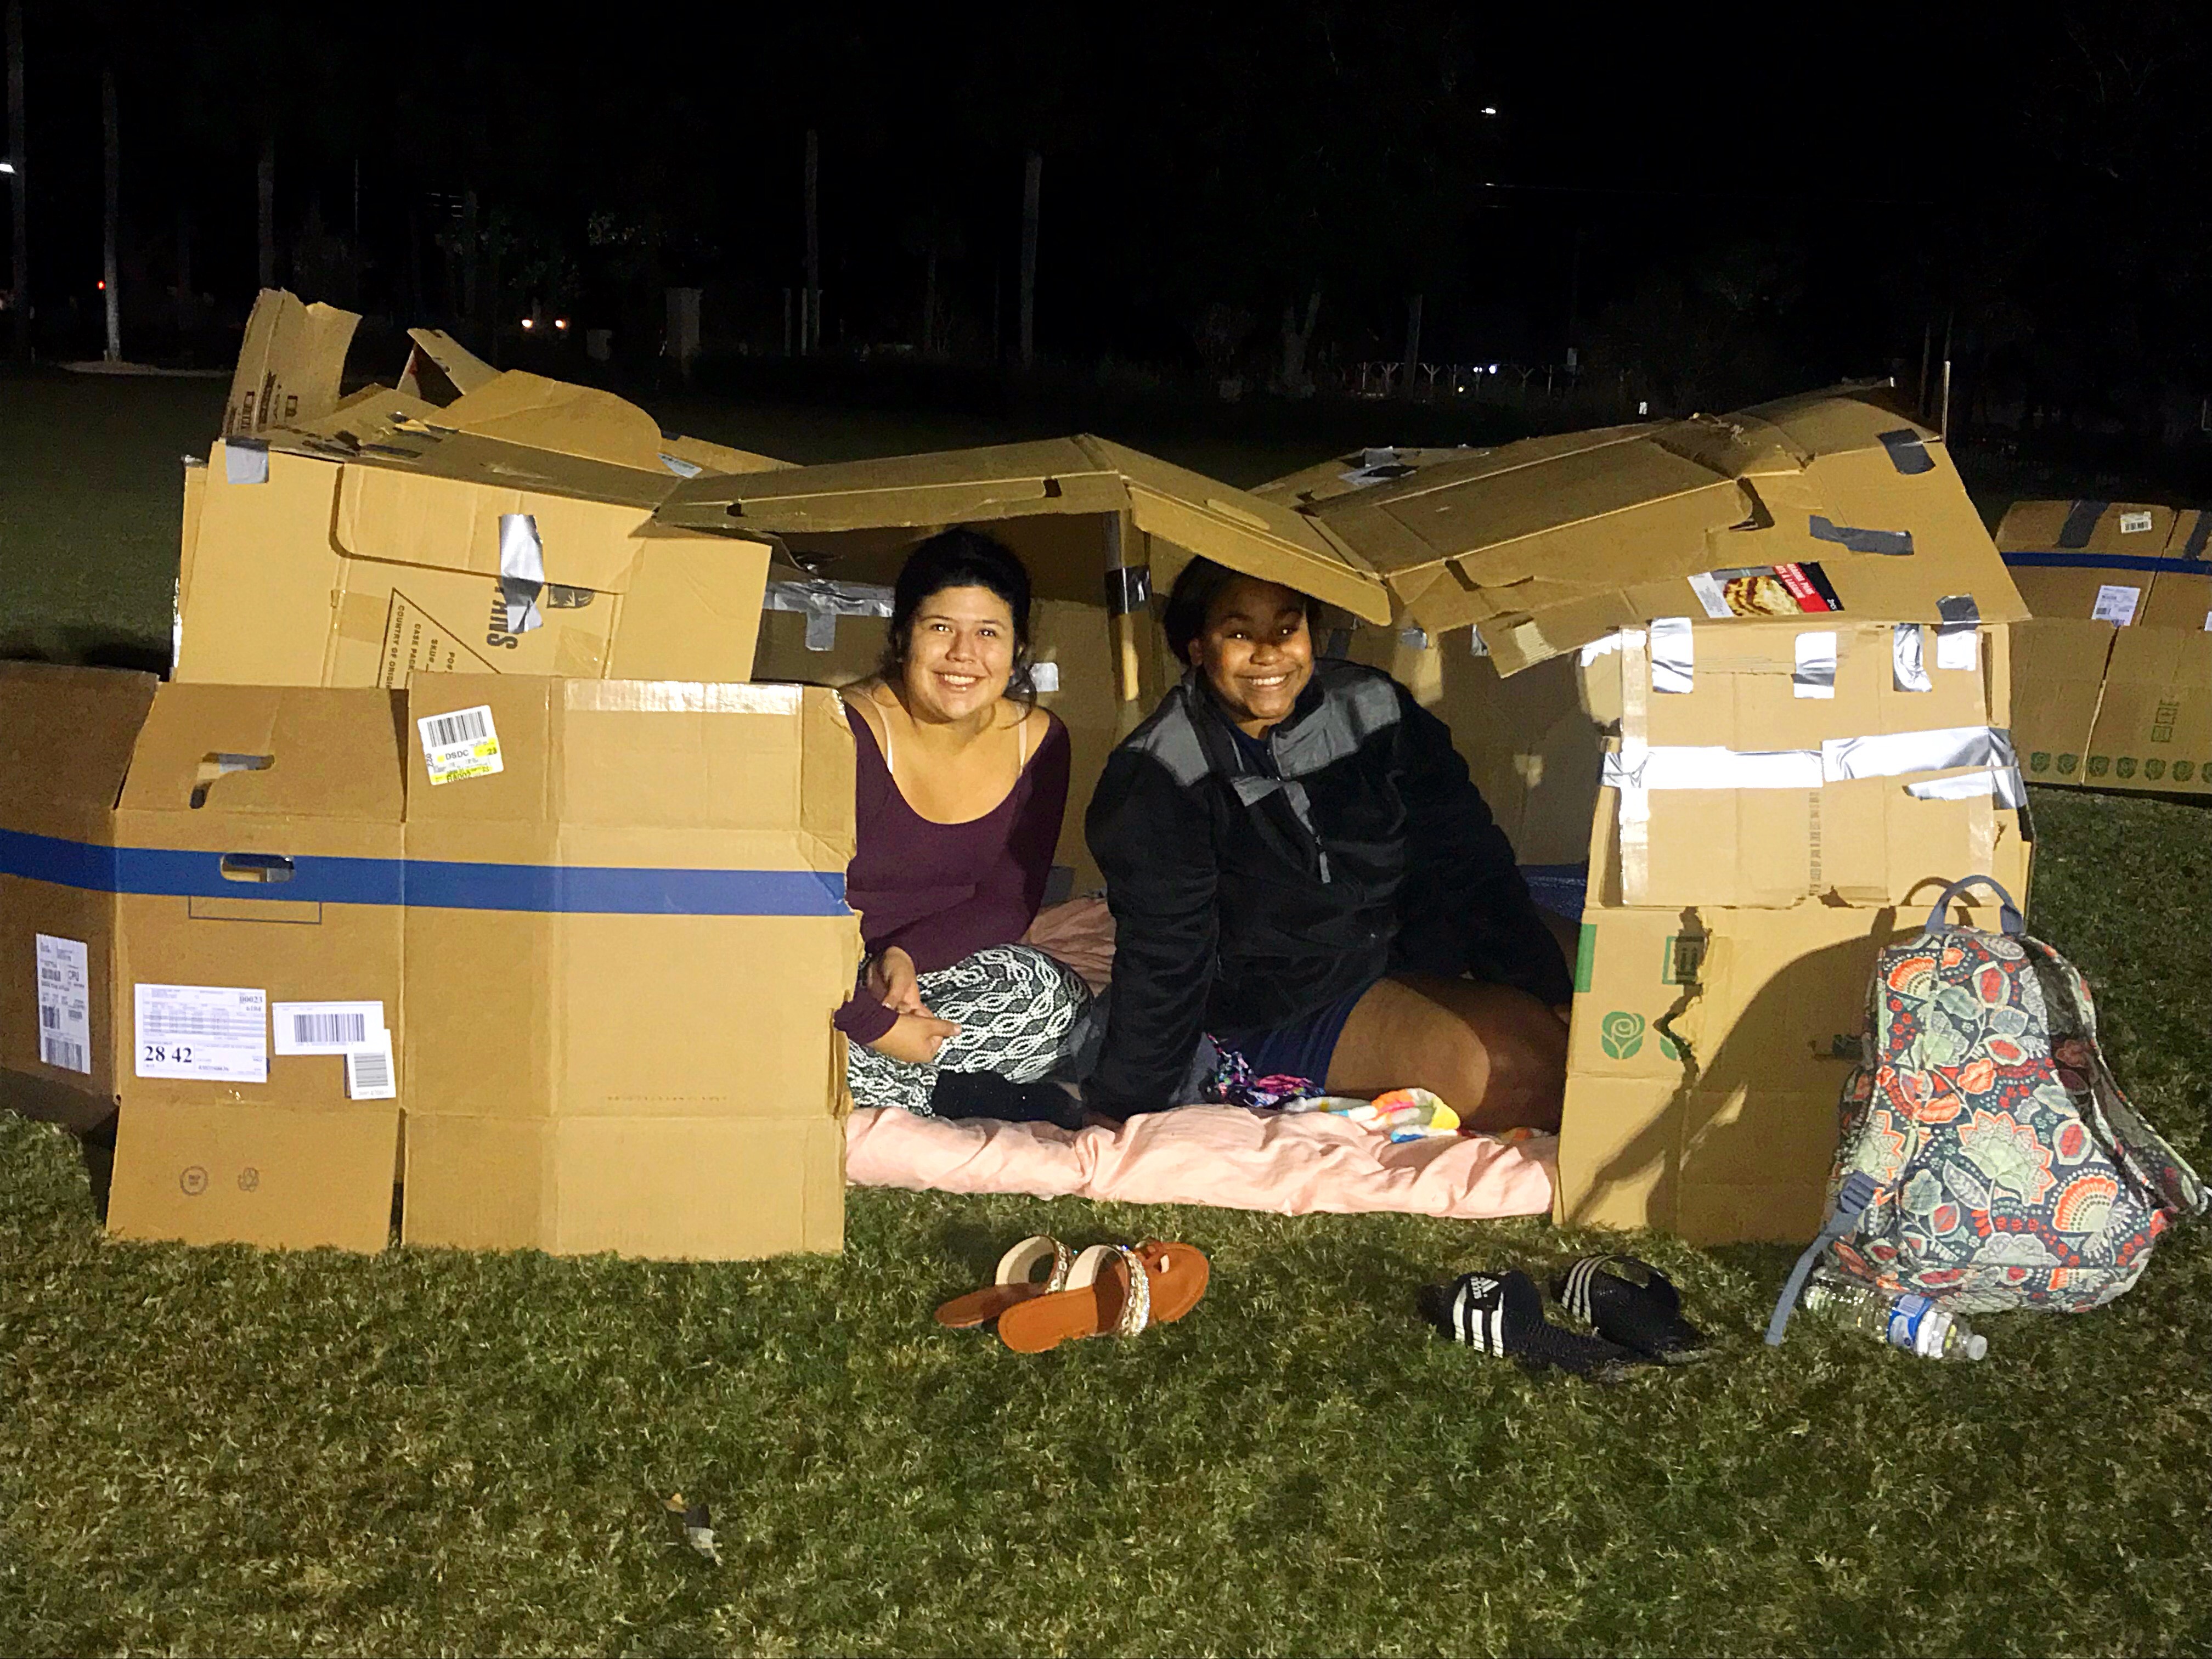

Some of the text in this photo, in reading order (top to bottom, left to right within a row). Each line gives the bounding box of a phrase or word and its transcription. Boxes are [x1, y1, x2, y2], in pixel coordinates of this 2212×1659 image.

[393, 605, 405, 646] COUNTRY
[391, 647, 398, 658] OF
[408, 623, 421, 670] CASE PACK
[445, 750, 469, 760] DSDC
[144, 1046, 192, 1063] 28 42
